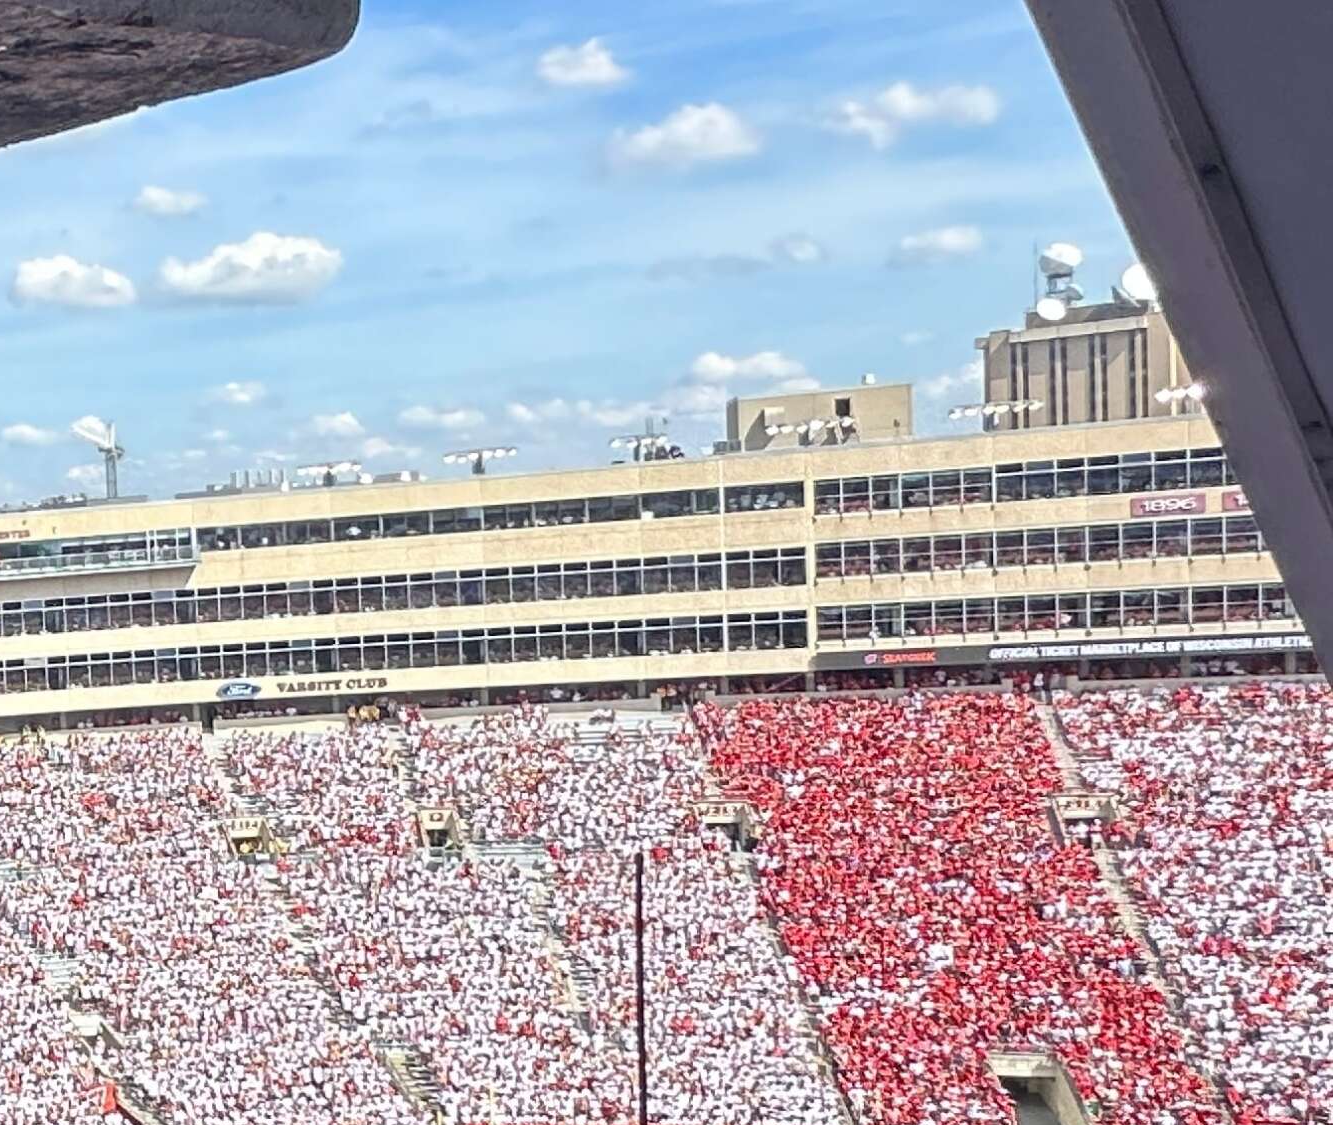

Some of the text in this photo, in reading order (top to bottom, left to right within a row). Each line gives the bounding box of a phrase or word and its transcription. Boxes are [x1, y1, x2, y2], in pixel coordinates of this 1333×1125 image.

[1140, 497, 1197, 512] 1896
[276, 677, 388, 693] VARSITY CLUB
